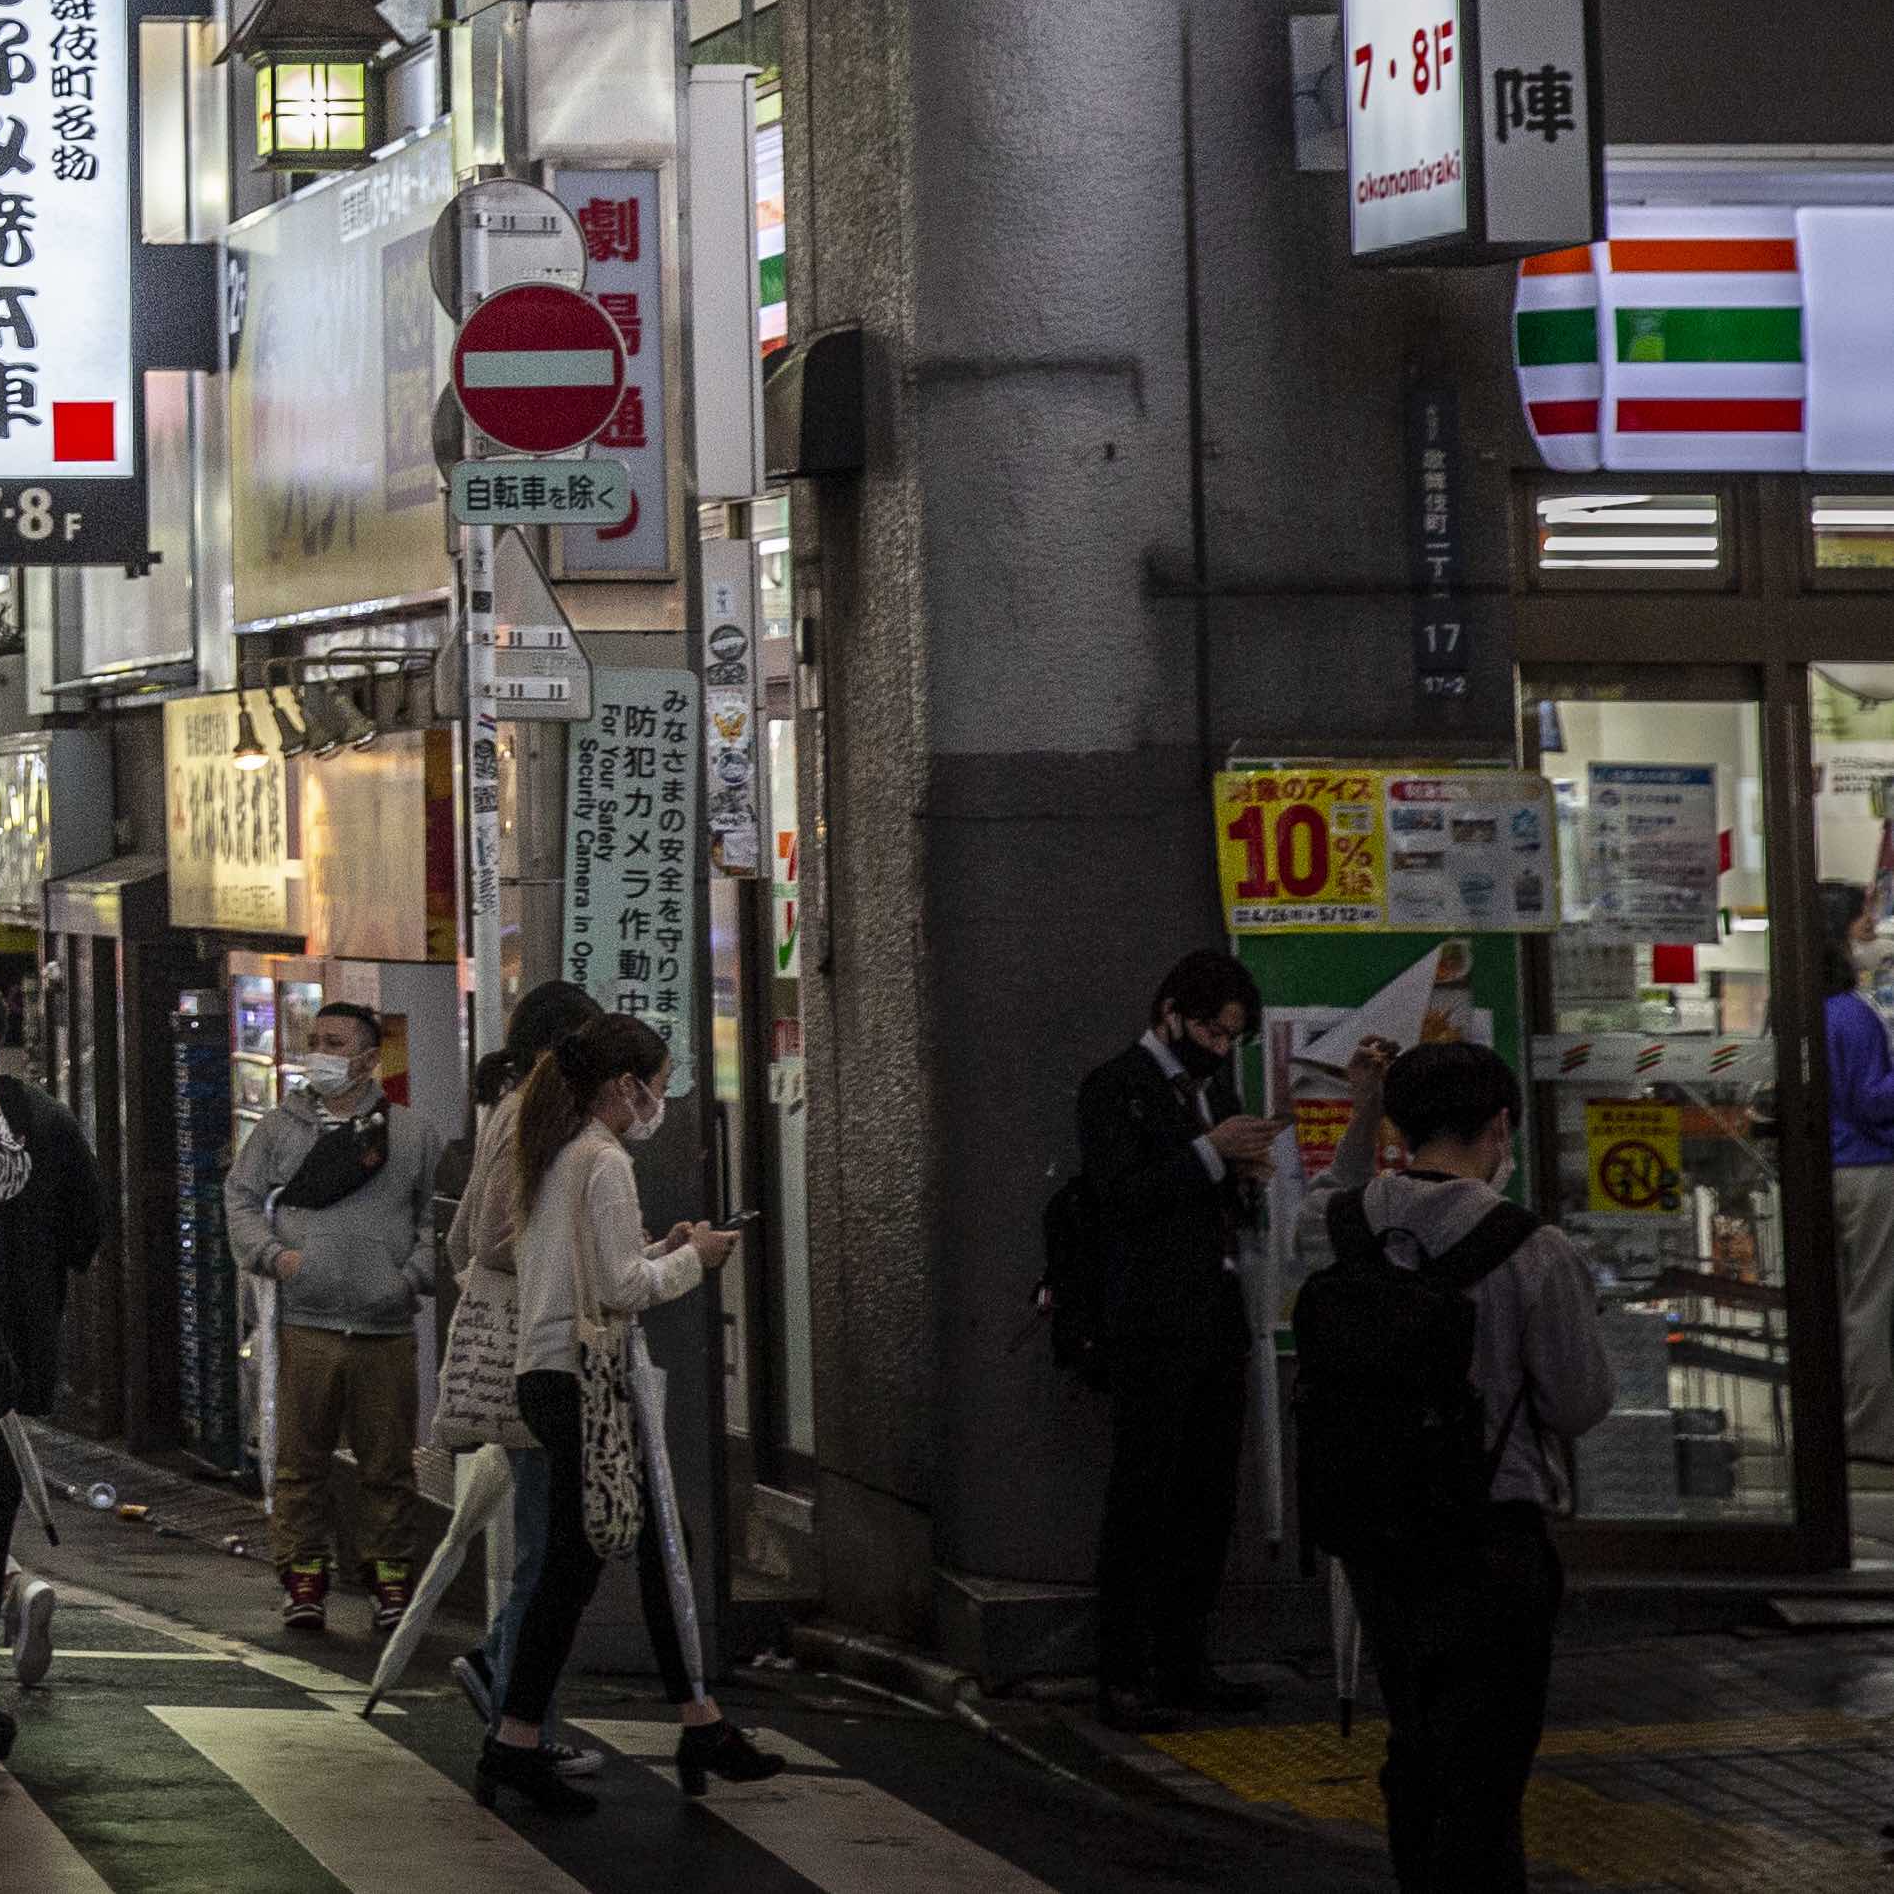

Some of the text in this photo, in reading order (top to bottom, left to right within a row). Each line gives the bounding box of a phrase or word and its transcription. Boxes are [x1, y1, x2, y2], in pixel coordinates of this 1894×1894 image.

[1357, 150, 1462, 206] okonomiyaki
[466, 476, 614, 511] 自転車を除く
[1424, 624, 1461, 652] 17
[573, 828, 596, 905] Camera
[1228, 805, 1329, 900] 10
